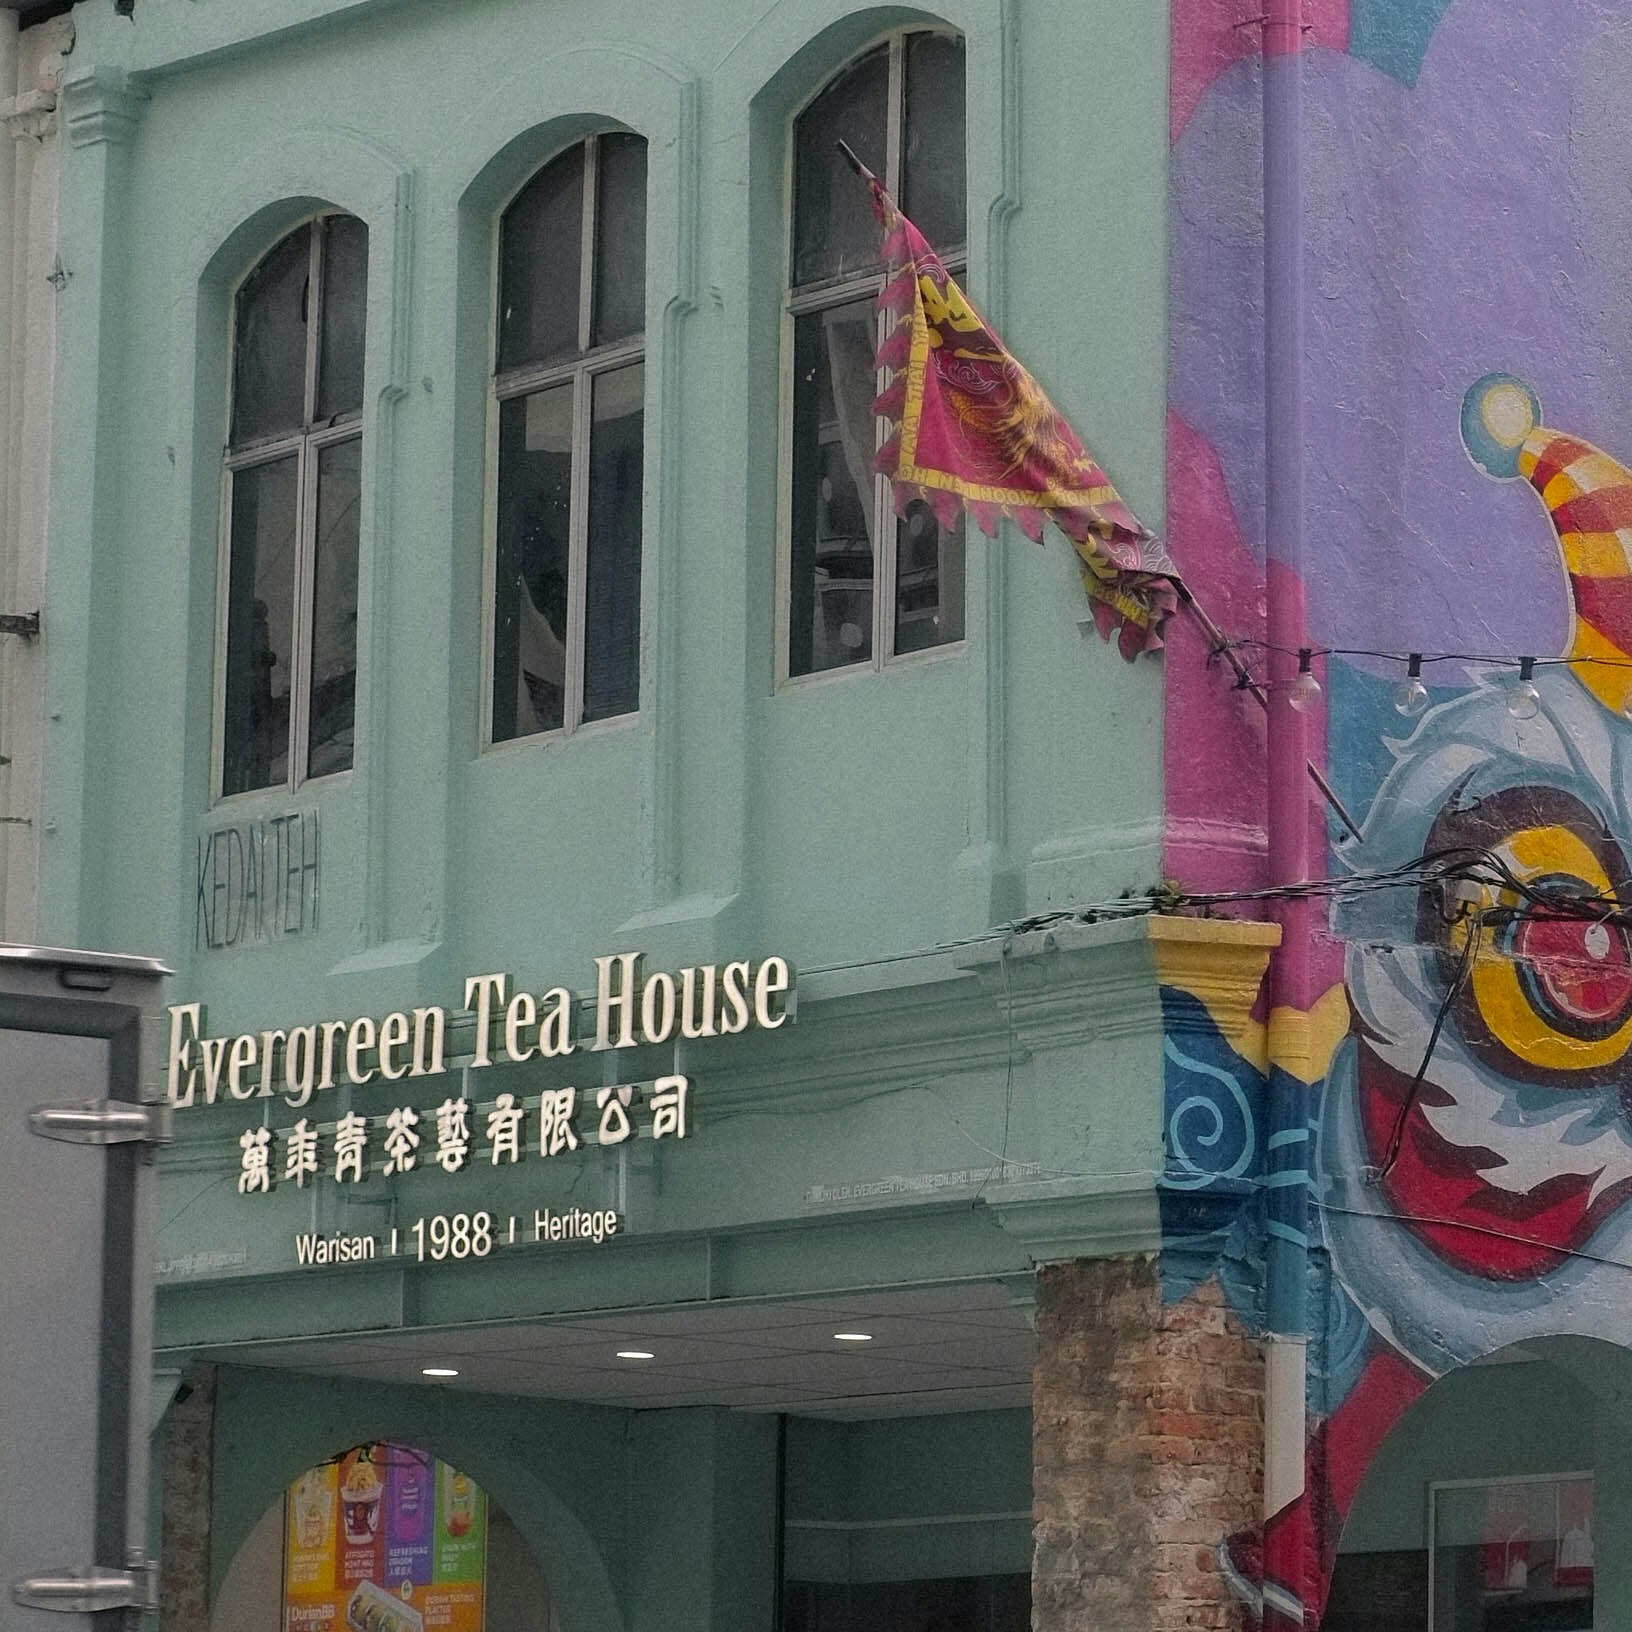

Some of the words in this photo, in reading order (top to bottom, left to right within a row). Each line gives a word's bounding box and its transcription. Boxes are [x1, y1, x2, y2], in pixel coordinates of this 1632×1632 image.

[166, 1002, 447, 1110] Evergreen
[464, 972, 577, 1069] Tea
[589, 951, 789, 1052] House
[296, 1232, 375, 1265] Warisan
[411, 1210, 493, 1263] 1988
[534, 1206, 617, 1245] Heritage
